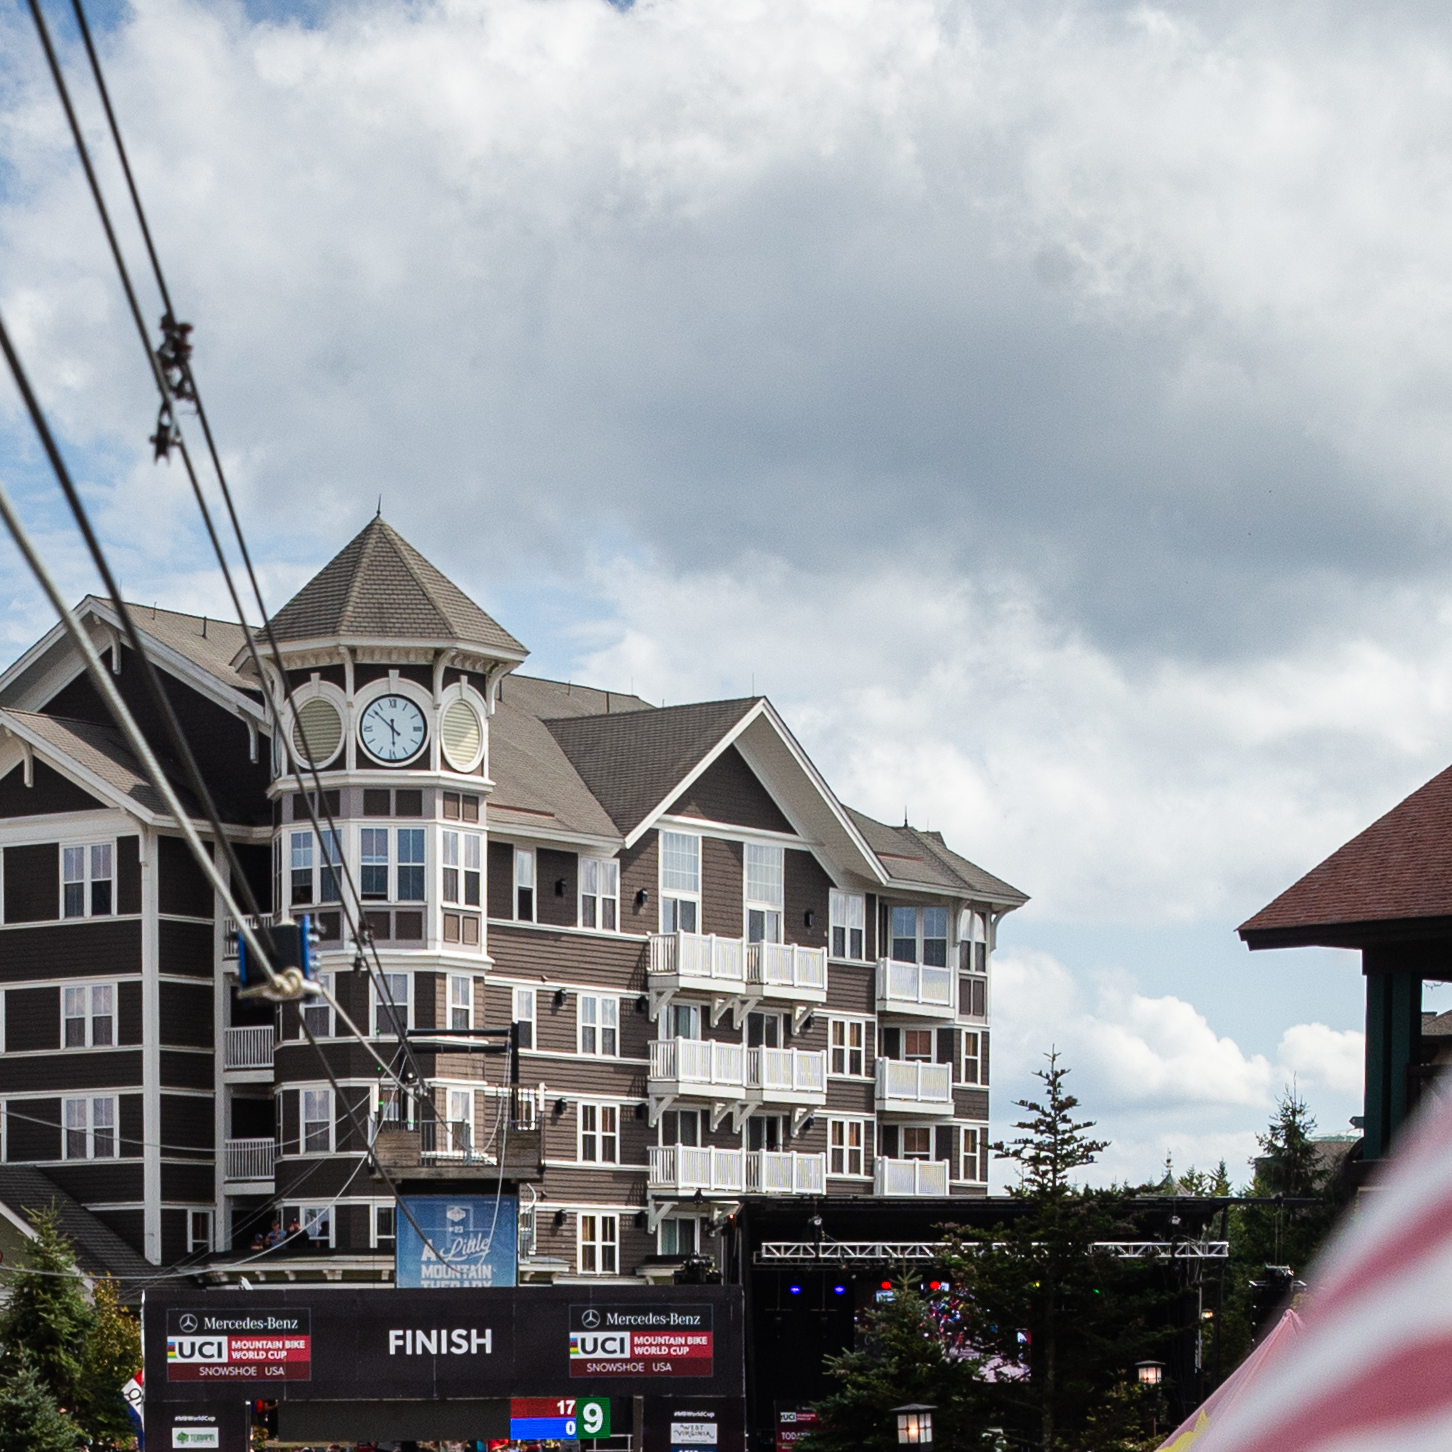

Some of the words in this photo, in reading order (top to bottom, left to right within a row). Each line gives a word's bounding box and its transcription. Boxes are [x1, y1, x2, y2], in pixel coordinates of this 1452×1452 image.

[421, 1239, 437, 1261] A
[439, 1232, 491, 1261] Little
[421, 1264, 492, 1279] MOUNTAIN
[204, 1316, 298, 1330] Mercedes-Benz
[606, 1312, 701, 1325] Mercedes-Benz
[231, 1340, 283, 1349] MOUNTAIN
[285, 1340, 305, 1349] BIKE
[389, 1328, 492, 1355] FINISH
[580, 1337, 625, 1355] UCI
[634, 1336, 685, 1345] MOUNTAIN
[687, 1336, 707, 1345] BIKE
[178, 1341, 223, 1359] UCI
[231, 1351, 266, 1359] WORLD
[268, 1351, 287, 1359] CUP
[634, 1346, 669, 1355] WORLD
[670, 1346, 689, 1355] CUP
[199, 1366, 257, 1376] SNOWSHOE
[265, 1366, 285, 1376] USA
[586, 1362, 645, 1372] SNOWSHOE
[652, 1362, 672, 1372] USA
[557, 1400, 576, 1415] 17
[582, 1402, 604, 1434] 9
[566, 1420, 576, 1435] 0
